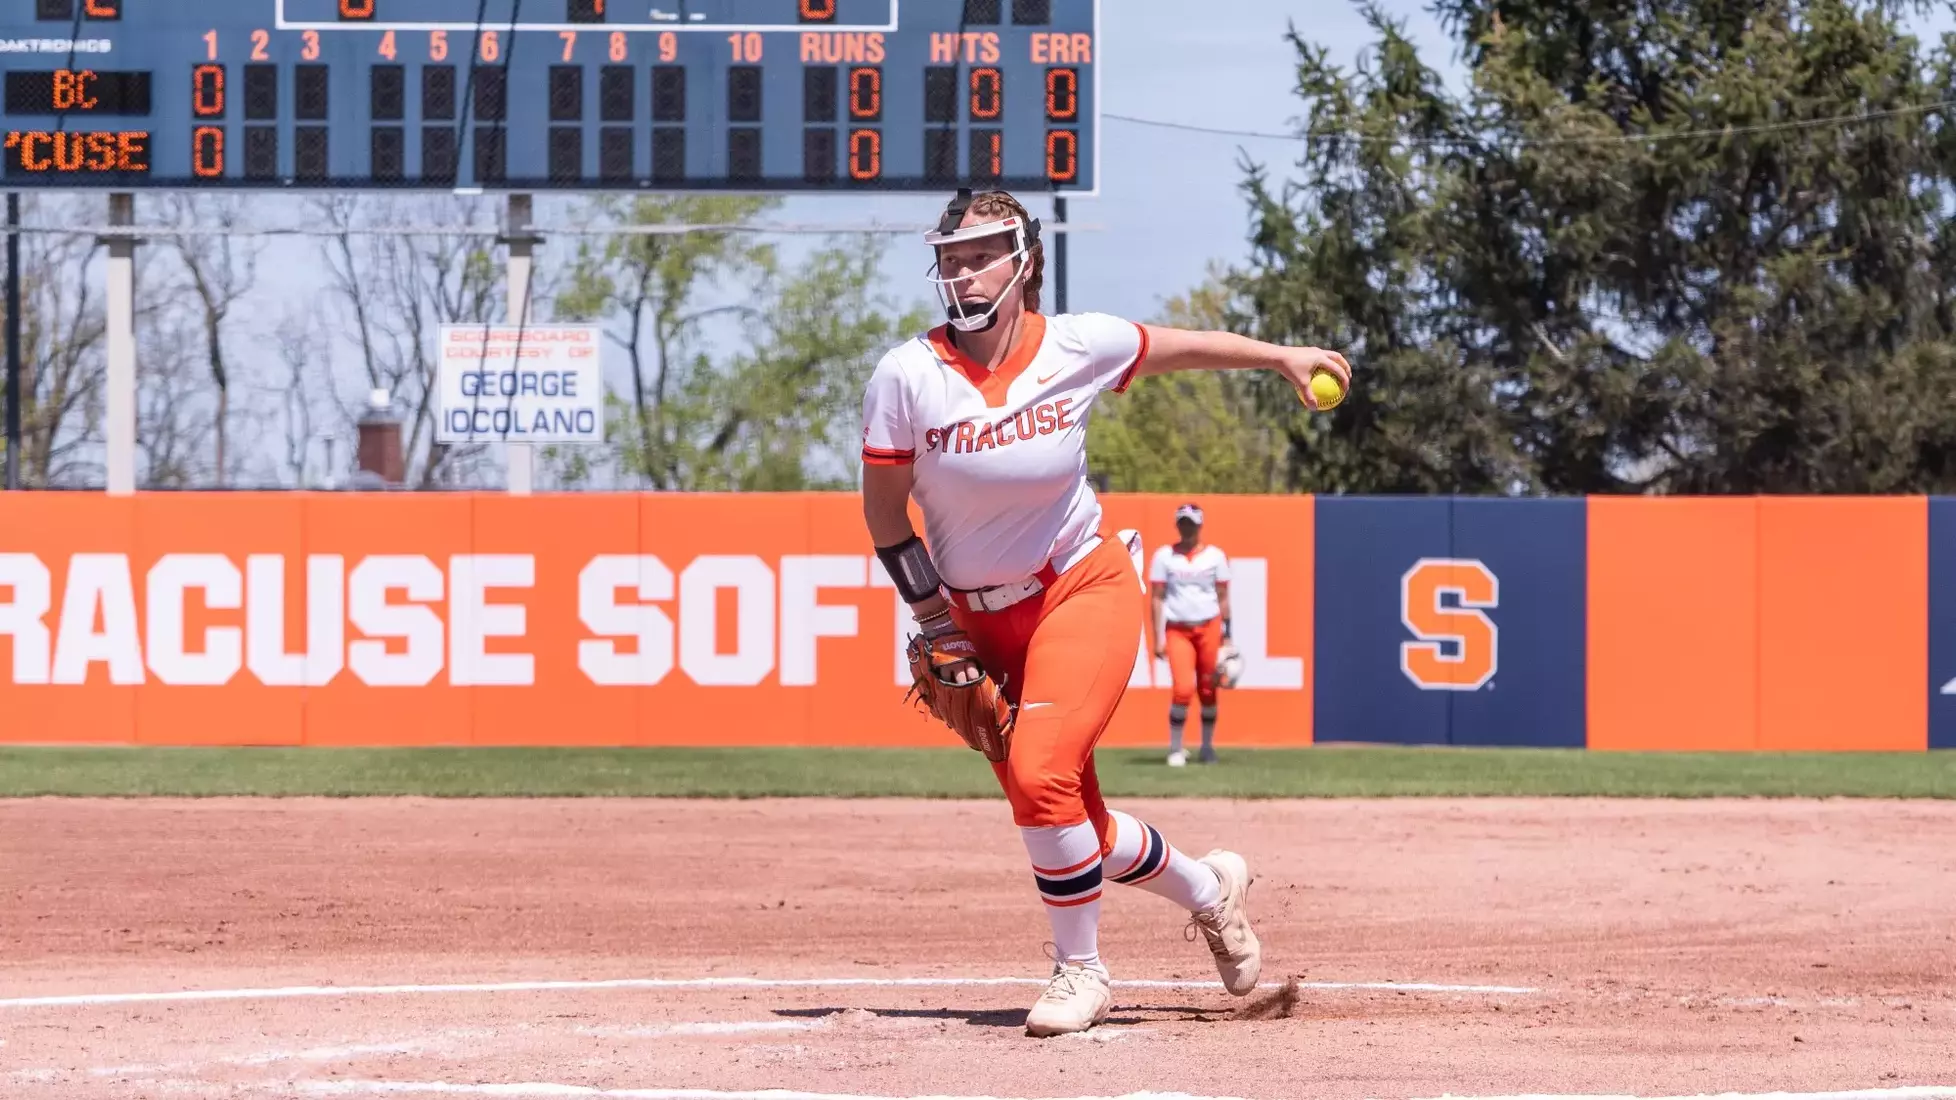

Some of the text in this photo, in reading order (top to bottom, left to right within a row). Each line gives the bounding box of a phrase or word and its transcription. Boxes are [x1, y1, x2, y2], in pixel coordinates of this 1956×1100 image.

[205, 30, 1091, 63] 1 2 3 4 5 6 7 8 9 10 RUNS HITS ERR
[53, 66, 1076, 118] BC 0 0 0 0
[194, 127, 223, 176] 0
[850, 130, 880, 179] 0
[991, 135, 1000, 174] 1
[1046, 131, 1076, 180] 0
[446, 347, 593, 358] COURTESY OF
[450, 330, 590, 342] SCOREBOARD
[461, 371, 577, 396] GEORGE
[445, 409, 594, 433] IOCOLANO
[926, 398, 1074, 454] SYRACUSE
[1400, 557, 1499, 691] S
